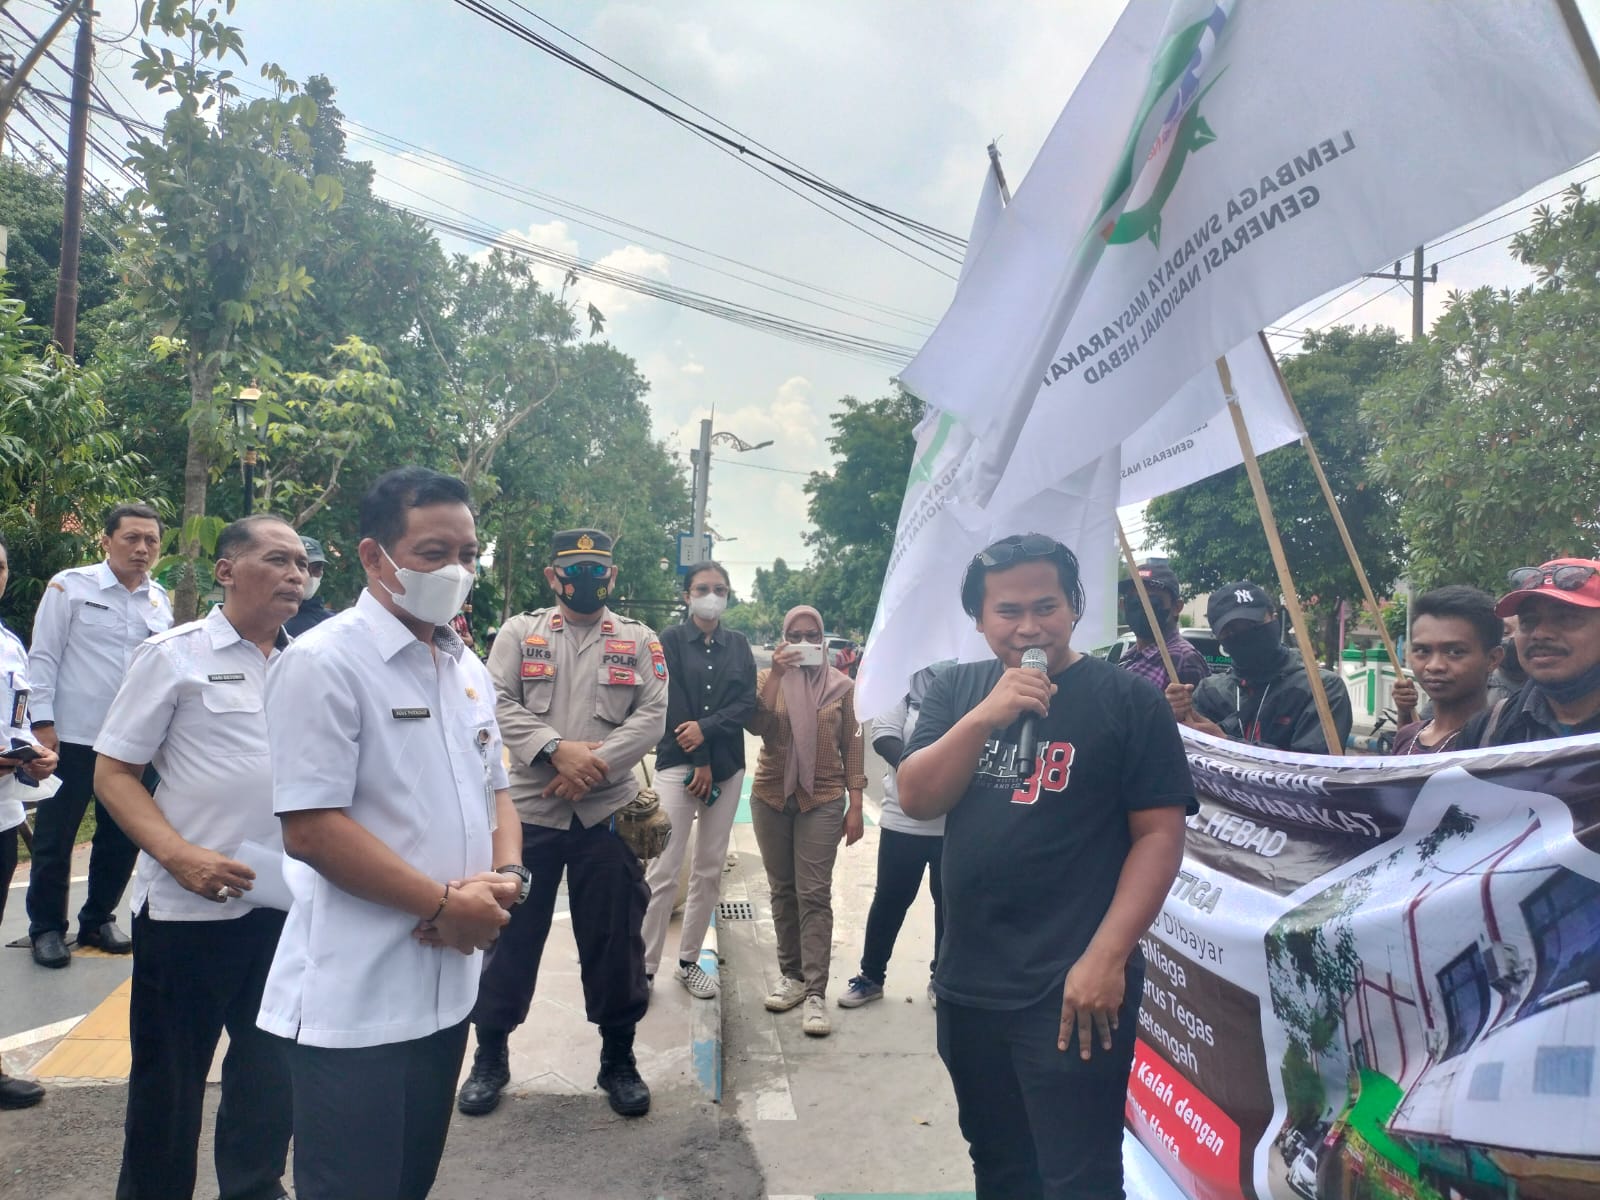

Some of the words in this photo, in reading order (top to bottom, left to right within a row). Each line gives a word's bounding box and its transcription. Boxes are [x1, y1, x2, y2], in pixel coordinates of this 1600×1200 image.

[603, 654, 637, 667] POLRI
[1203, 811, 1288, 857] HEBAD
[1163, 912, 1224, 965] Dibayar
[1138, 1006, 1198, 1075] setengah
[1168, 991, 1215, 1047] Tegas
[1137, 1061, 1174, 1107] Kalah
[1175, 1097, 1225, 1157] dengan
